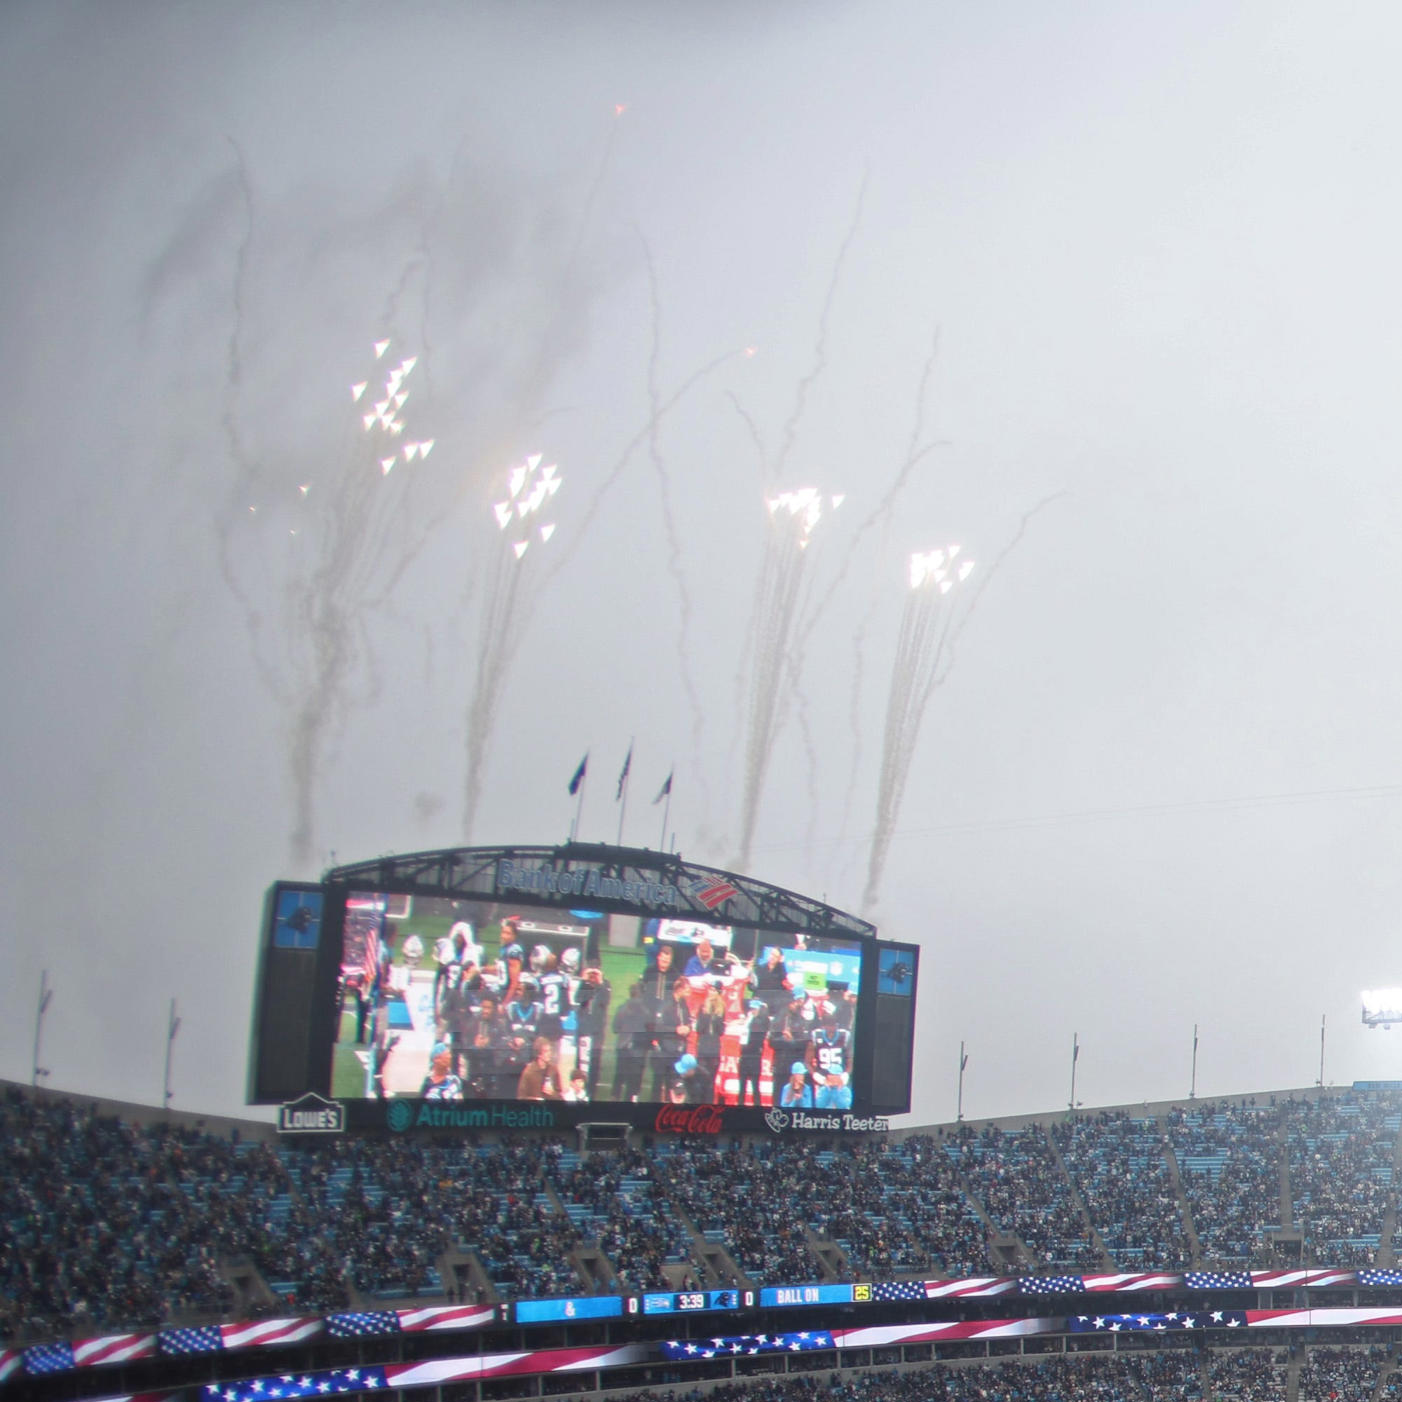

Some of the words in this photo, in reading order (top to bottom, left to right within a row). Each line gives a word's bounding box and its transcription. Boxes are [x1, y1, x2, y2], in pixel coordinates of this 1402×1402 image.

[498, 858, 556, 893] Bank
[558, 867, 584, 894] of
[584, 868, 678, 905] America
[417, 1106, 488, 1127] Atrium
[491, 1106, 553, 1127] Health
[792, 1112, 840, 1130] Harris
[679, 1294, 704, 1309] 3:39
[745, 1292, 753, 1306] 0
[777, 1289, 802, 1304] BALL
[804, 1288, 819, 1303] ON
[854, 1286, 869, 1300] 25
[629, 1298, 638, 1313] 0
